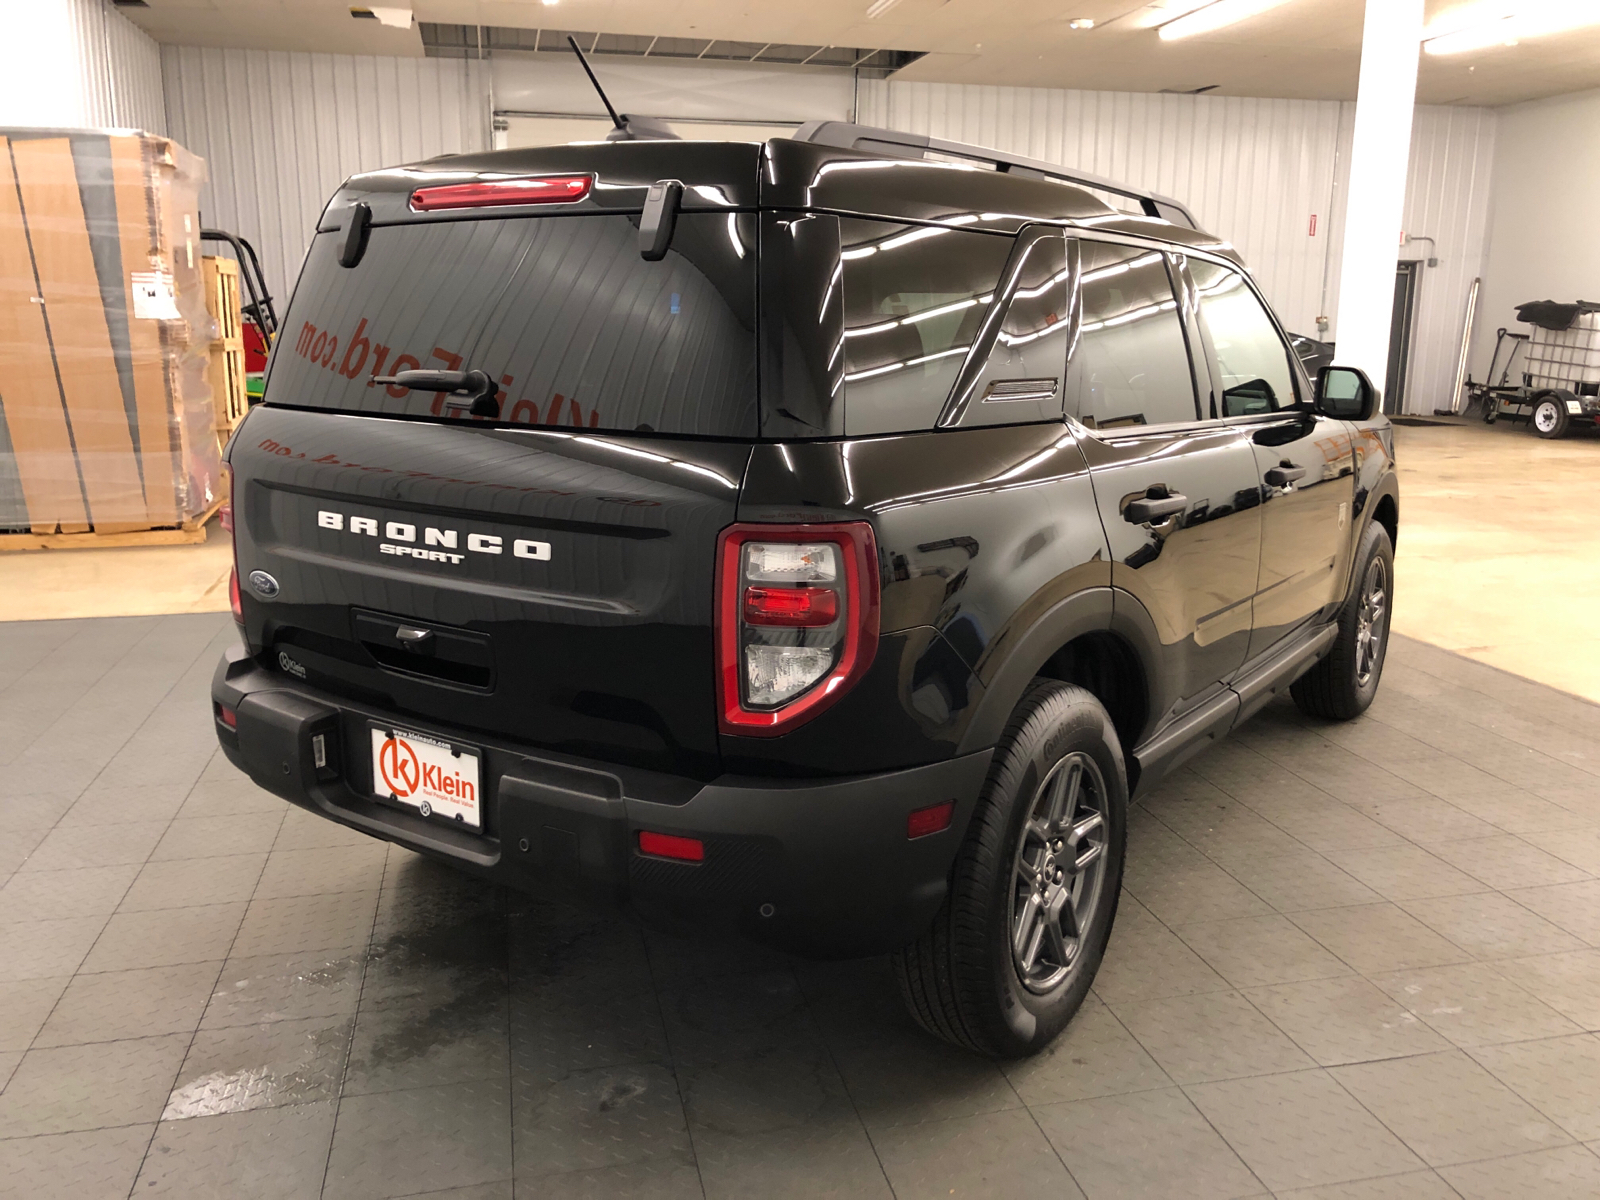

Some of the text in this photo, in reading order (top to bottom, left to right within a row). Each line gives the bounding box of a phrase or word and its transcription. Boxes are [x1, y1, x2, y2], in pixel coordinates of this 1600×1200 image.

[318, 510, 551, 561] BRONCO
[380, 543, 465, 564] SPORT
[289, 659, 306, 674] Klein
[392, 729, 451, 750] www.kleinauto.com
[422, 762, 475, 801] Klein
[433, 792, 449, 801] People.
[450, 796, 460, 804] Real
